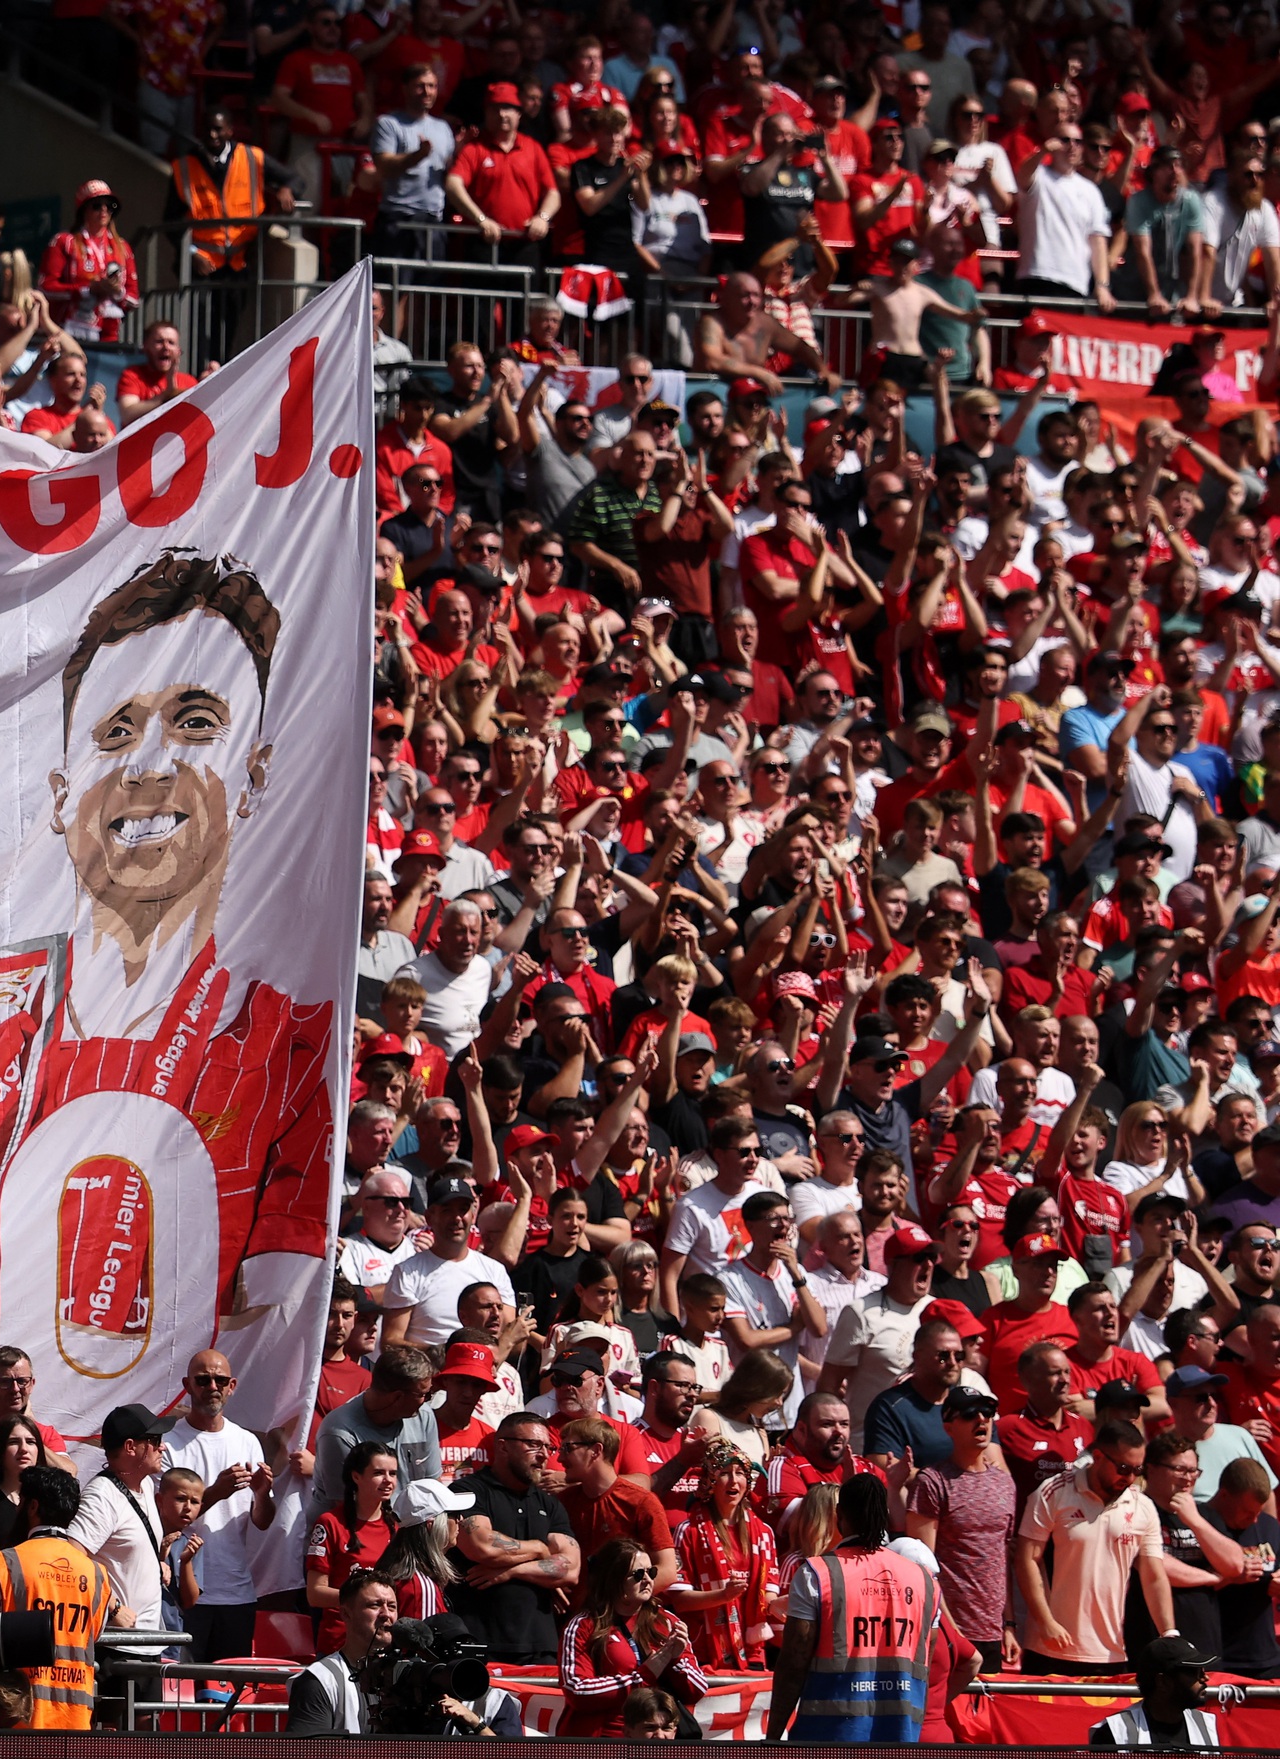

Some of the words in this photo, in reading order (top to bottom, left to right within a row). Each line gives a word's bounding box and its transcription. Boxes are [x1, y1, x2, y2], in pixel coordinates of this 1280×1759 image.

[1052, 333, 1163, 387] LIVERP
[254, 336, 363, 489] J.
[151, 1021, 198, 1096] League
[88, 1240, 133, 1328] Leagu
[472, 1350, 486, 1361] 20
[439, 1446, 489, 1463] VERPOOL
[1038, 1459, 1074, 1470] Standar
[37, 1571, 78, 1584] WEMBLEY
[860, 1587, 902, 1597] WEMBLEY
[50, 1666, 87, 1684] STEWAR
[851, 1681, 878, 1692] HERE
[879, 1680, 894, 1691] TO
[896, 1680, 911, 1691] HE
